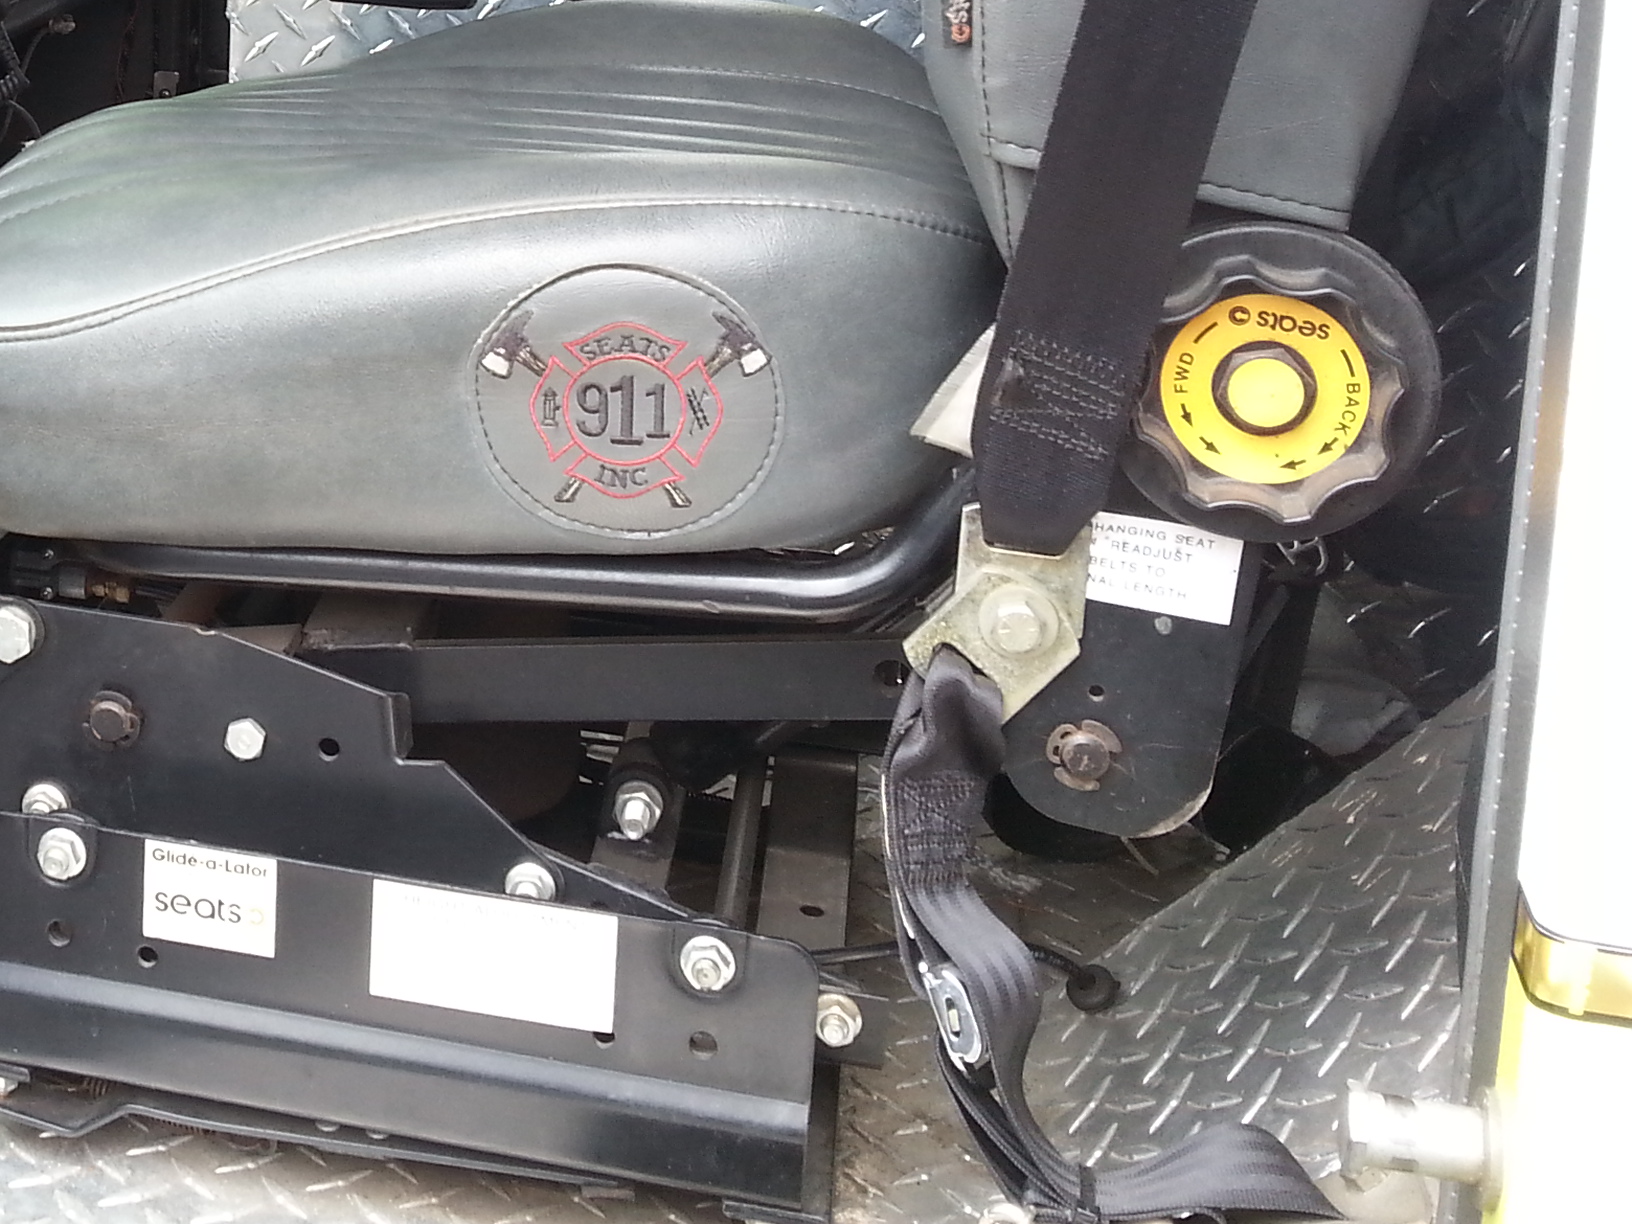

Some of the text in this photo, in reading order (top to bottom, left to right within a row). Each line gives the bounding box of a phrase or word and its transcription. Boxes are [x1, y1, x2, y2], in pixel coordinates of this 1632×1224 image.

[1256, 309, 1332, 341] seats
[578, 333, 671, 363] SEATS
[1173, 351, 1195, 395] FWD
[575, 375, 671, 446] 911
[1333, 382, 1362, 437] BACK
[593, 463, 649, 490] INC
[1092, 521, 1167, 542] HANGING
[1174, 533, 1216, 550] SEAT
[1089, 555, 1167, 578] BELTS TO
[1110, 539, 1194, 564] READJUST
[1123, 580, 1188, 600] LENGTH
[151, 847, 268, 878] Glide-a-Lator
[154, 891, 242, 924] seats
